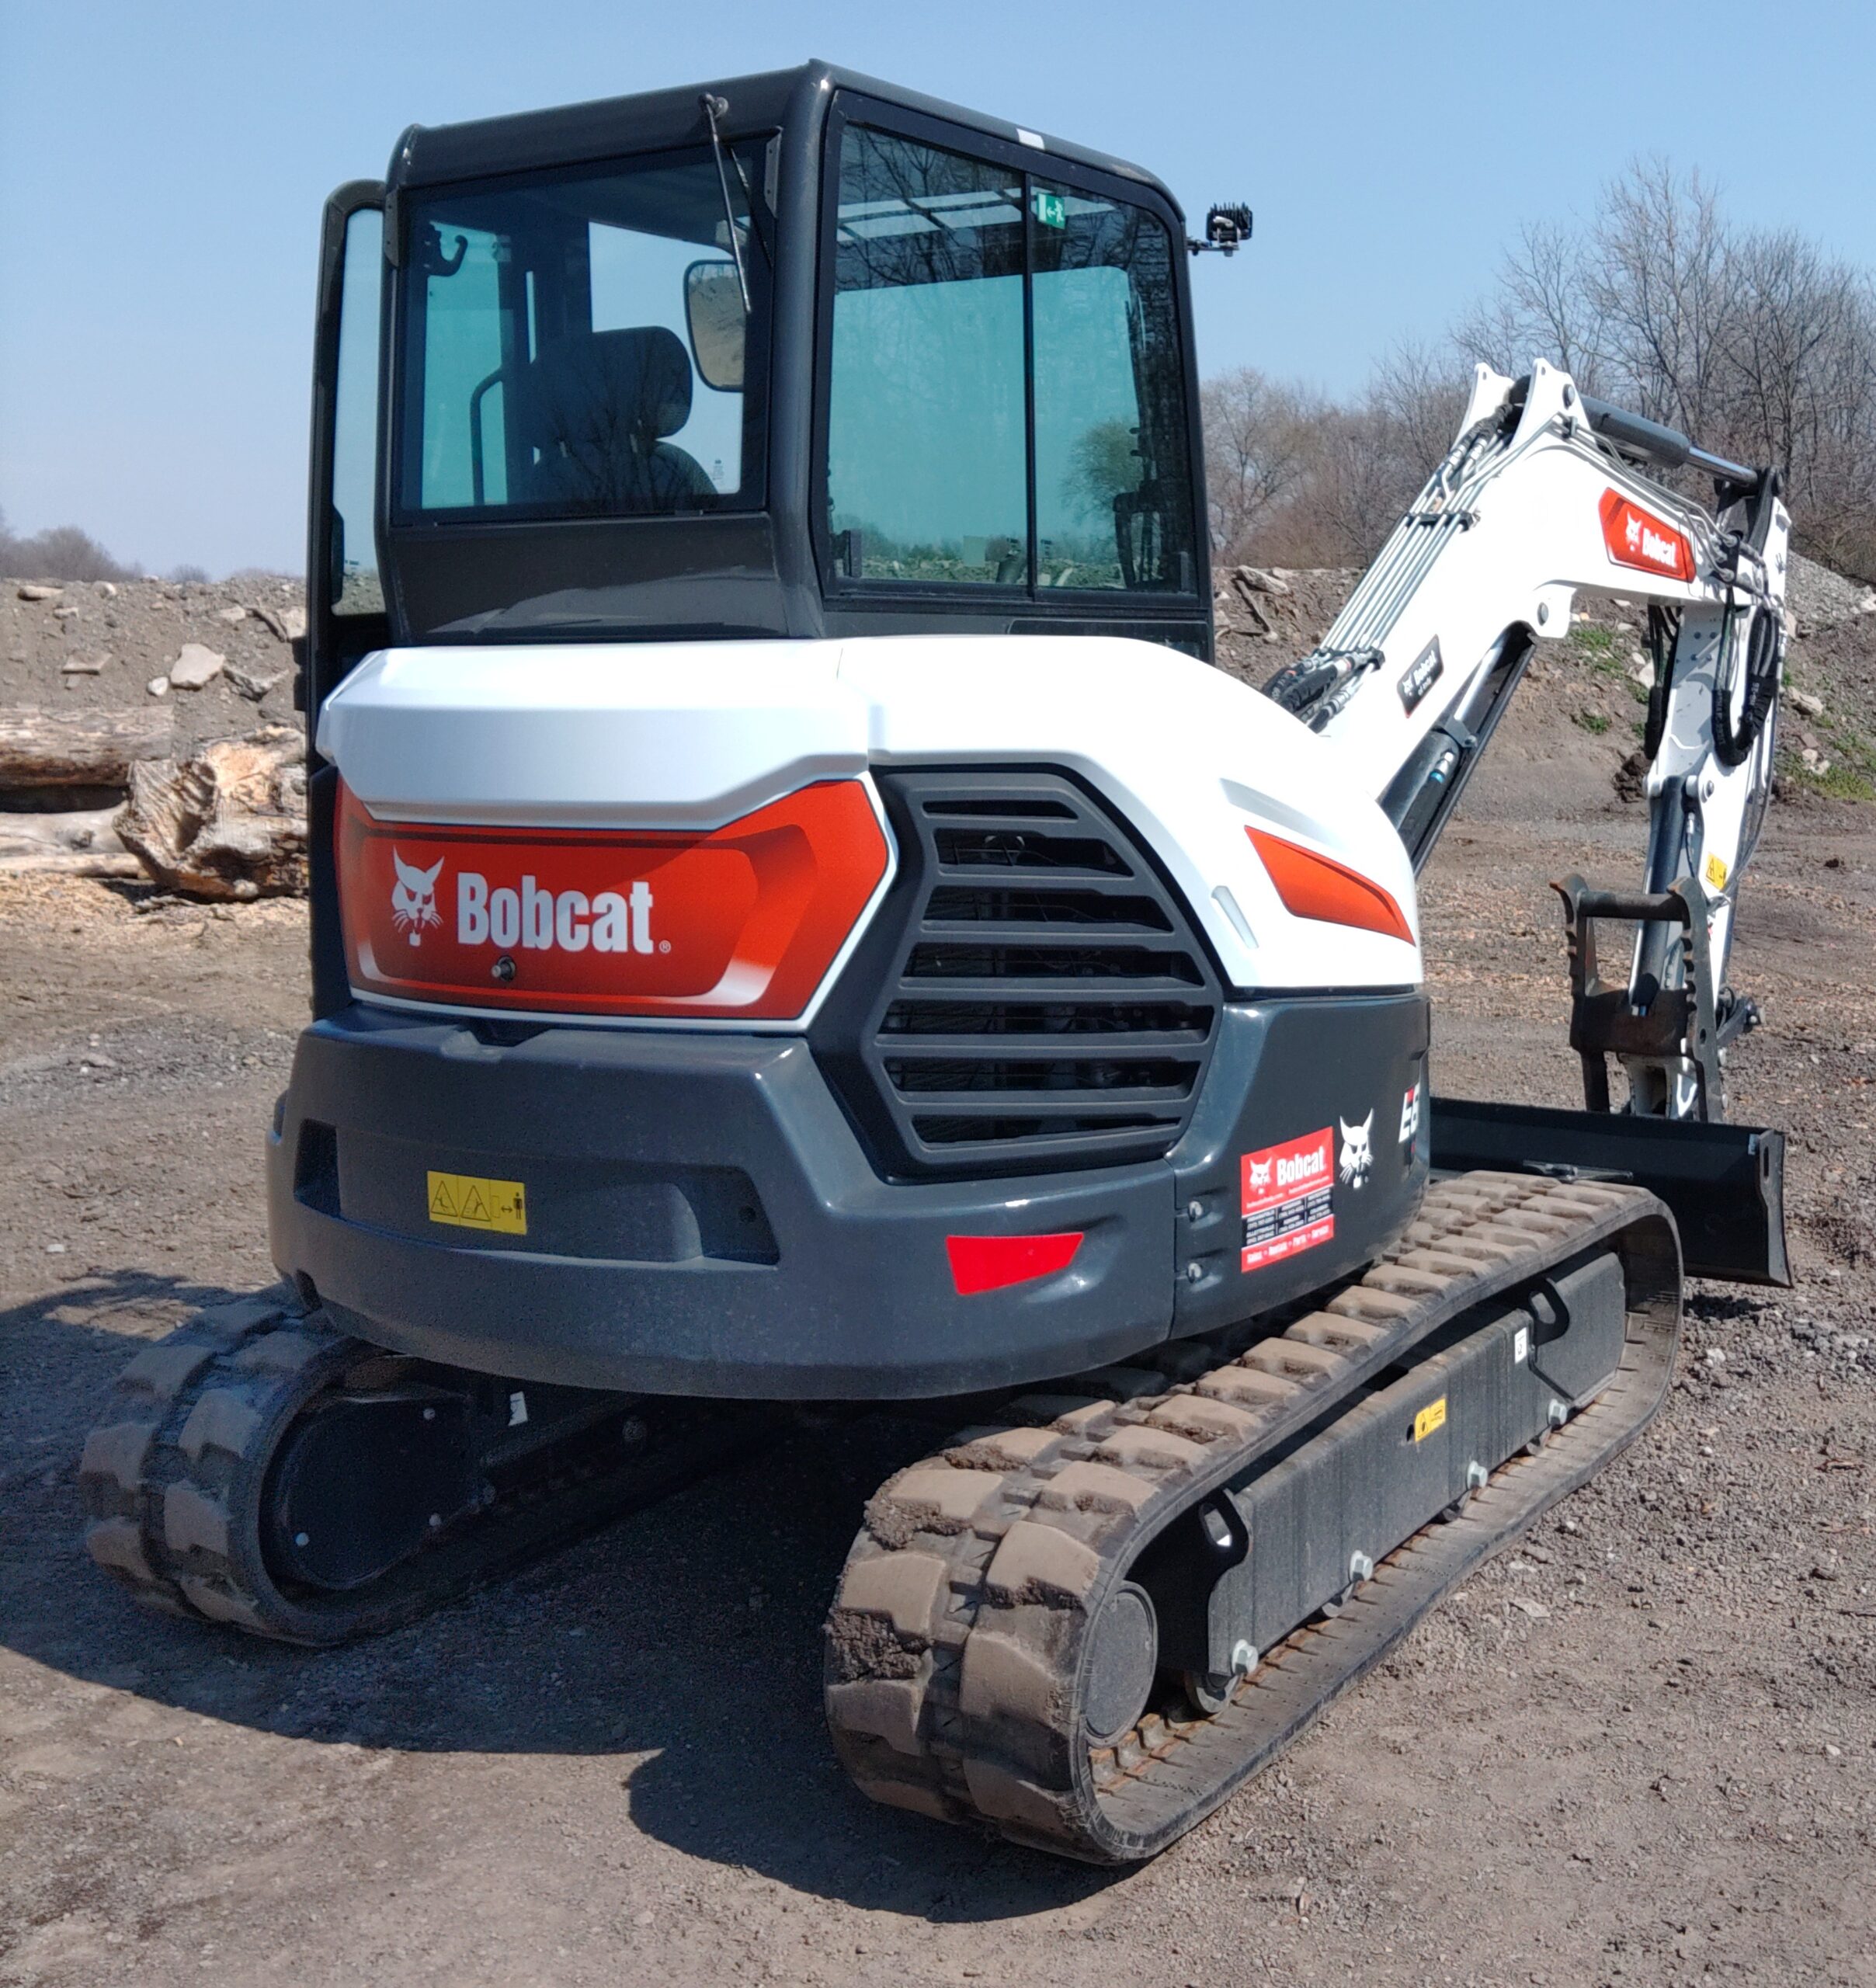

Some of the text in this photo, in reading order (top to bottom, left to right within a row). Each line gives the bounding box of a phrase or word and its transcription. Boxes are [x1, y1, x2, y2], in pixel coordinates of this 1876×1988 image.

[1642, 527, 1676, 568] Bobcat
[457, 872, 654, 954] Bobcat
[1277, 1145, 1325, 1186] Bobcat
